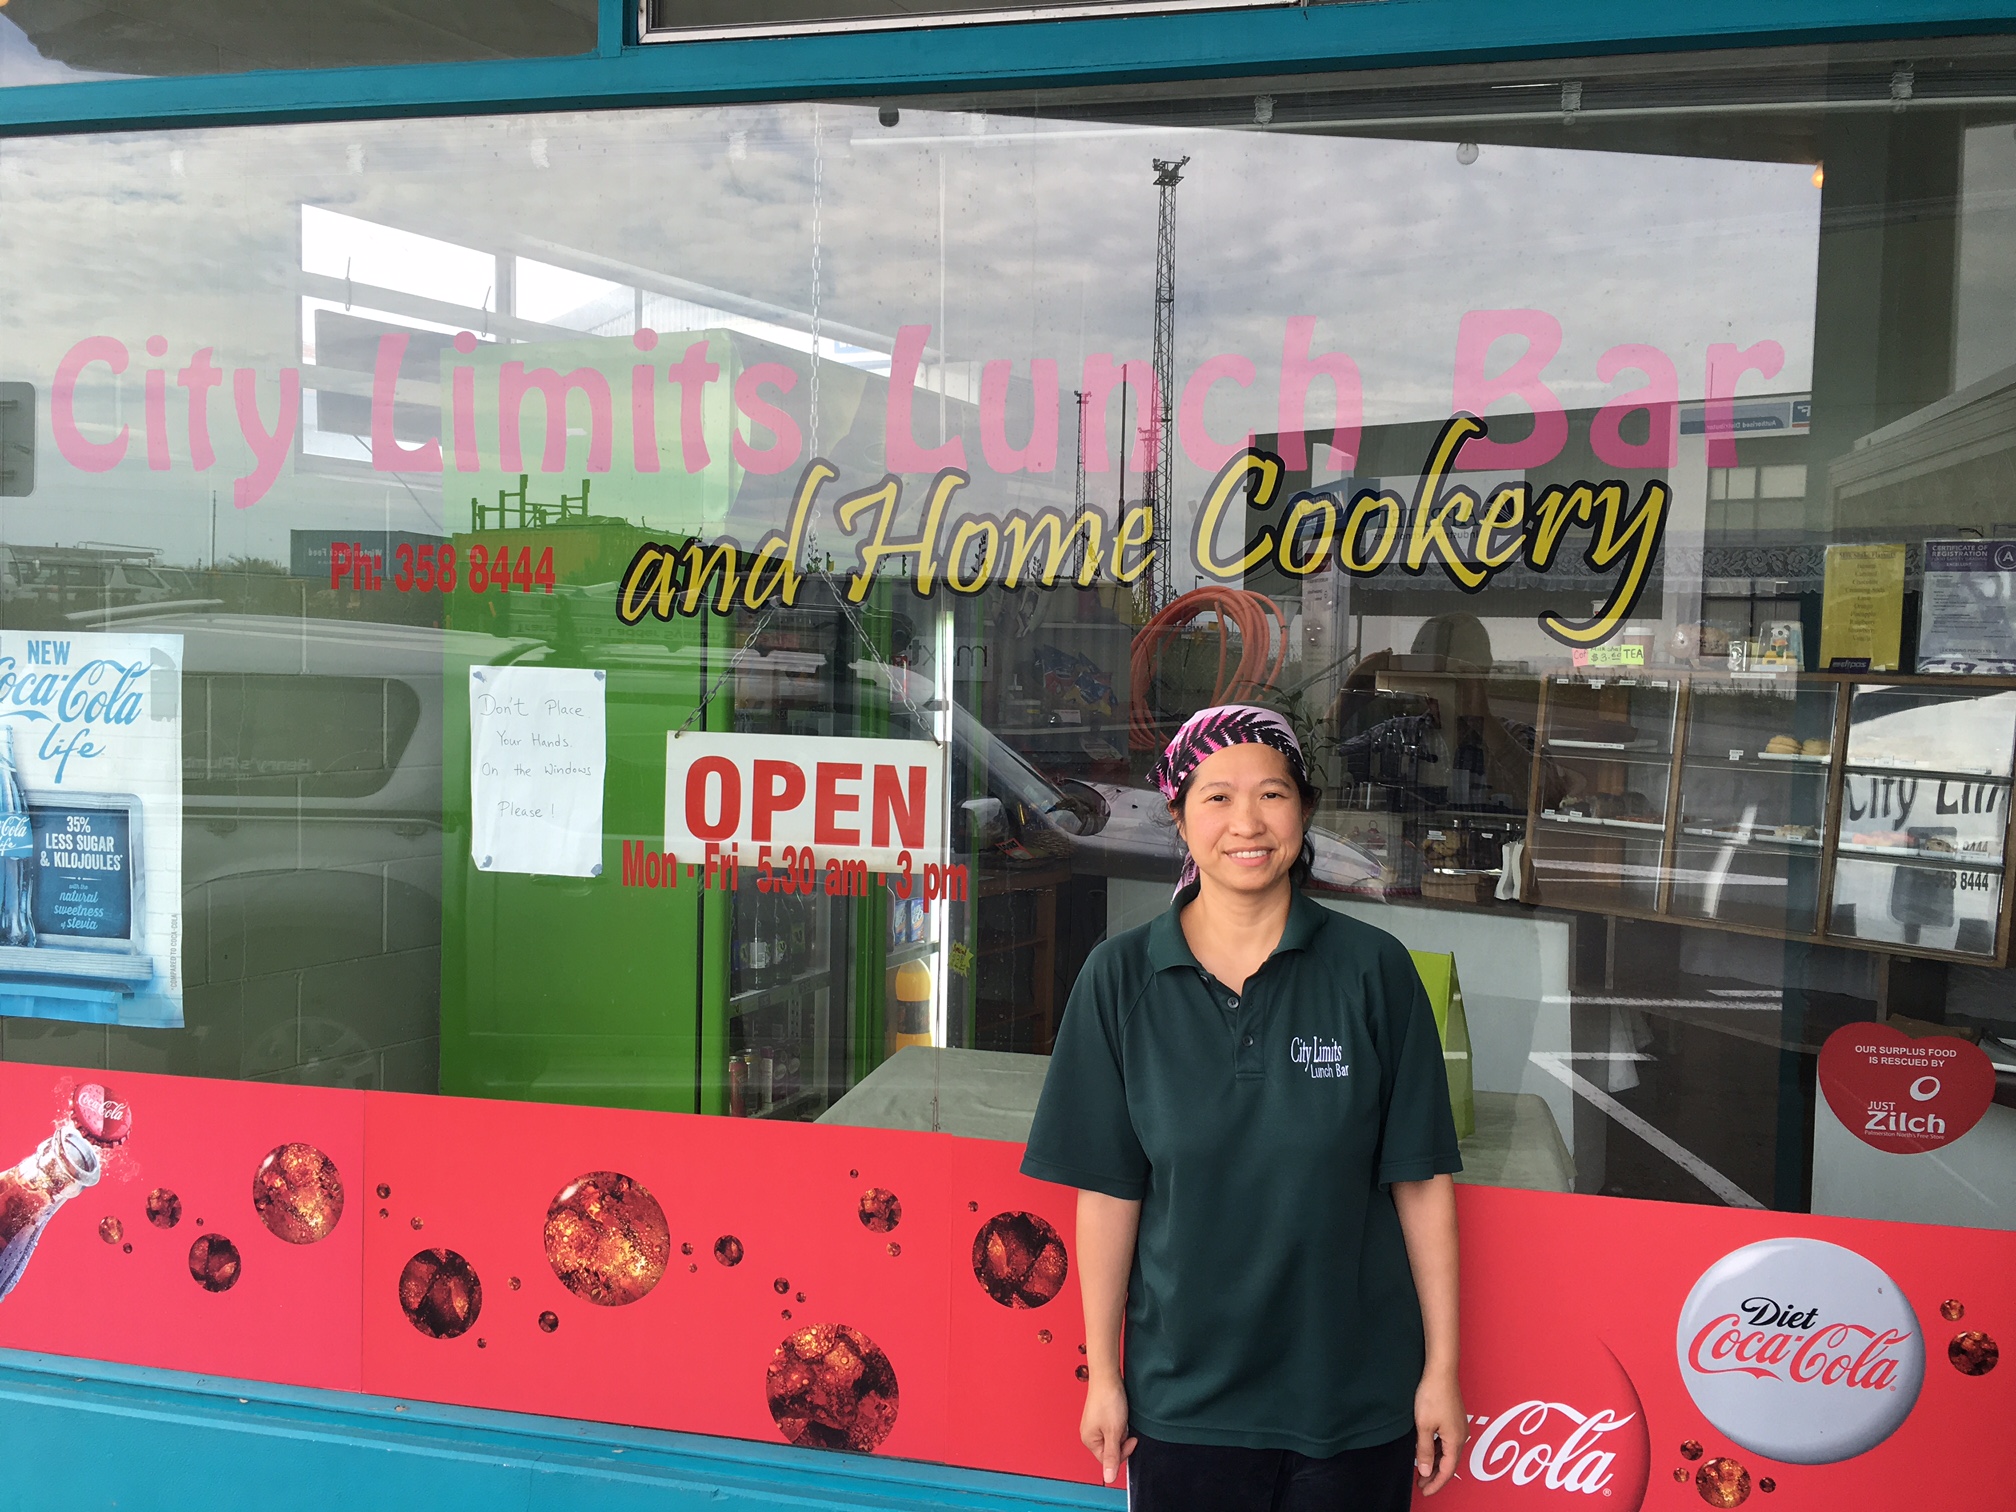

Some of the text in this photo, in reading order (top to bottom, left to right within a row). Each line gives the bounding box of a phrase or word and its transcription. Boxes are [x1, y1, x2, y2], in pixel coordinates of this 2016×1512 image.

[51, 308, 1785, 509] City Limits Lunch Bar
[616, 411, 1673, 648] and Home Cookery
[331, 542, 556, 594] Ph: 358 8444
[28, 640, 71, 666] NEW
[1623, 649, 1644, 659] TEA
[478, 693, 529, 716] Don't
[496, 730, 522, 746] Your
[38, 723, 106, 784] life
[482, 762, 499, 776] On
[514, 763, 532, 777] the
[684, 755, 928, 850] OPEN
[66, 816, 91, 833] 35%
[45, 833, 115, 852] LESS SUGAR
[40, 851, 50, 867] &
[622, 840, 677, 888] Mon
[705, 842, 738, 891] Fri
[757, 845, 815, 895] 5.30
[825, 858, 867, 896] am
[896, 850, 912, 899] 3
[923, 861, 968, 913] pm
[59, 890, 99, 903] natural
[54, 904, 104, 917] sweetness
[66, 918, 98, 930] stevia
[1290, 1035, 1343, 1072] City Limits
[1855, 1045, 1957, 1058] OUR SURPLUS FOOD
[1310, 1063, 1349, 1078] Lunch Bar
[1869, 1056, 1879, 1064] IS
[1881, 1057, 1929, 1067] RESCUED
[1867, 1101, 1896, 1111] JUST
[1865, 1110, 1946, 1134] Zilch
[1741, 1297, 1819, 1330] Diet
[1688, 1313, 1912, 1391] Coca-Cola
